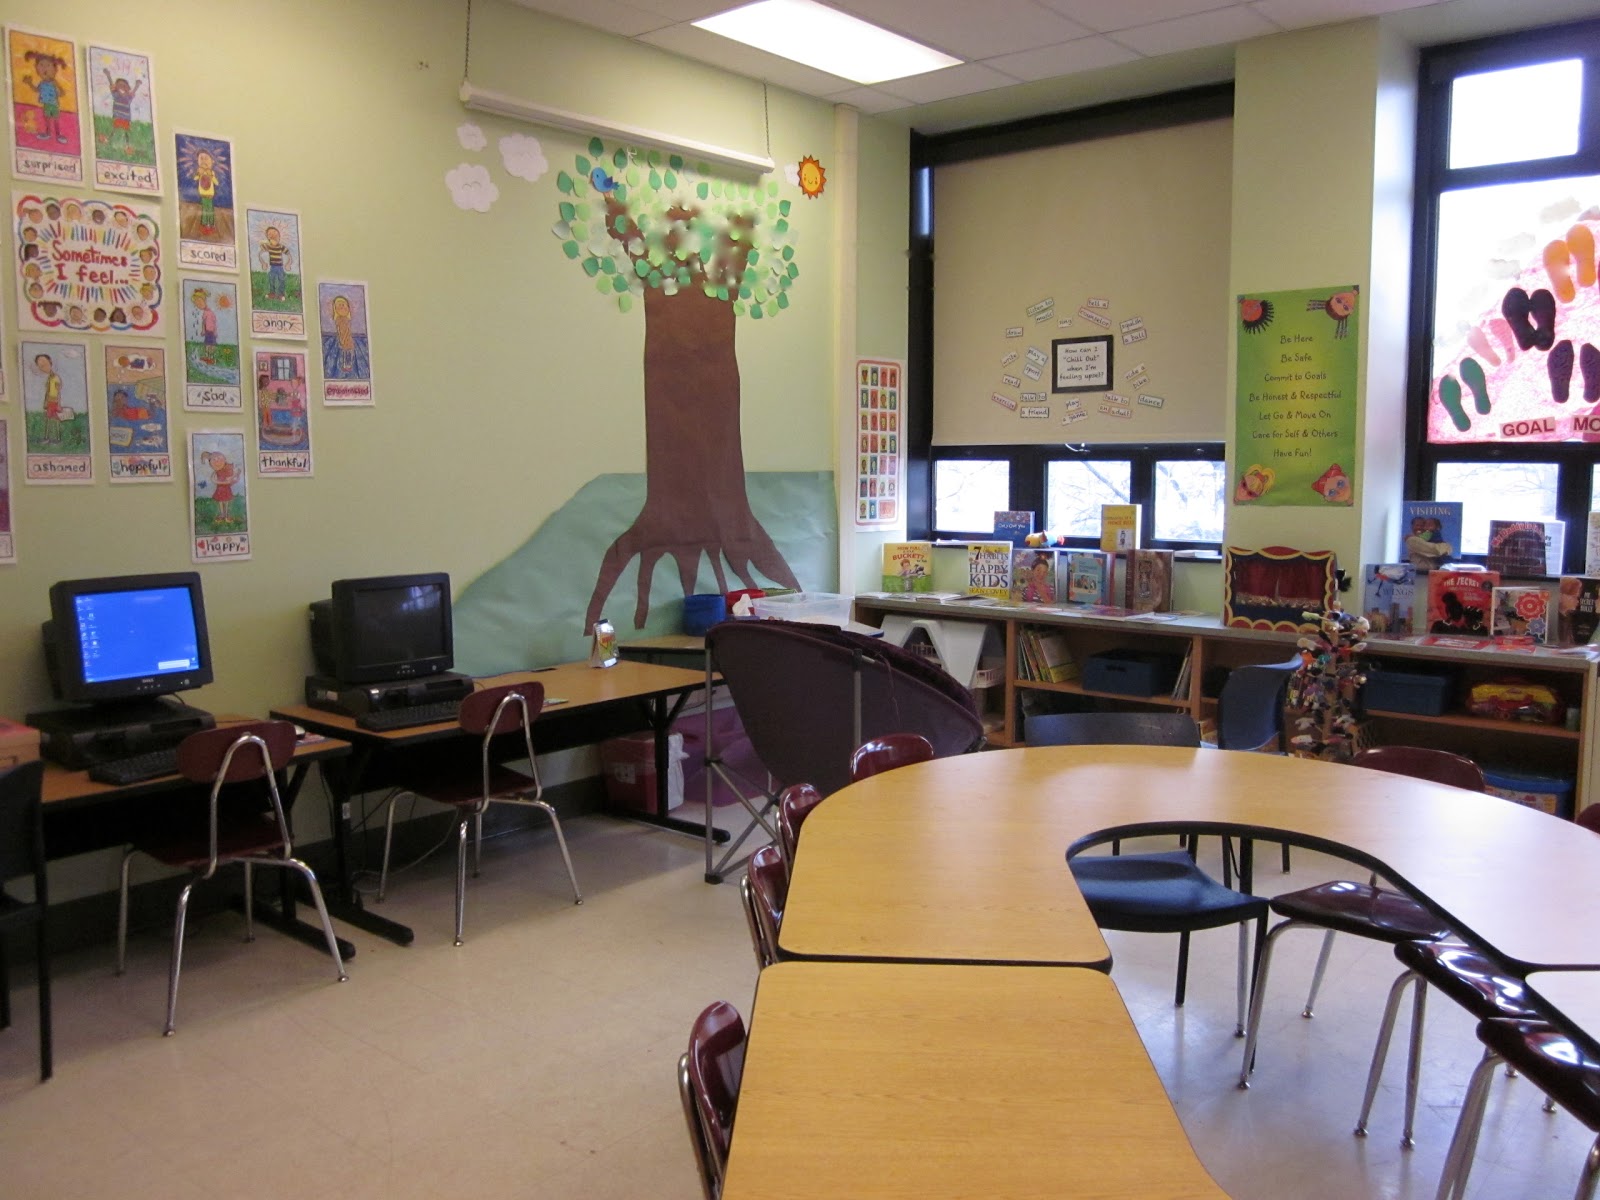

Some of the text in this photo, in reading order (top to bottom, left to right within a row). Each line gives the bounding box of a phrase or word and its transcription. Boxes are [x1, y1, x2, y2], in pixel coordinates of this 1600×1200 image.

[24, 160, 76, 173] surprised
[104, 170, 152, 183] excited
[52, 240, 128, 267] Sometimes
[190, 247, 227, 263] scared
[55, 263, 129, 285] I feel...
[263, 318, 294, 330] angry
[1281, 333, 1313, 344] Be Here
[1281, 353, 1312, 363] Be Safe
[1264, 373, 1292, 382] Commit
[1304, 371, 1327, 380] Goals
[1249, 390, 1342, 402] Be Honest & Respectful
[1259, 410, 1331, 420] Let Go & Move On
[1252, 428, 1338, 439] Care for Self & Others
[1502, 419, 1554, 436] GOAL
[1273, 448, 1312, 457] Have Fun!
[33, 461, 86, 473] ashamed
[120, 459, 162, 475] hopeful
[261, 456, 307, 469] thankful
[206, 539, 241, 552] happy
[892, 553, 925, 561] BUCKET?
[973, 546, 982, 560] 7
[980, 552, 1009, 560] HABITS
[969, 563, 1008, 574] HAPPY
[969, 574, 1008, 588] KIDS
[1456, 576, 1479, 588] SECRET
[1382, 588, 1414, 597] WINGS
